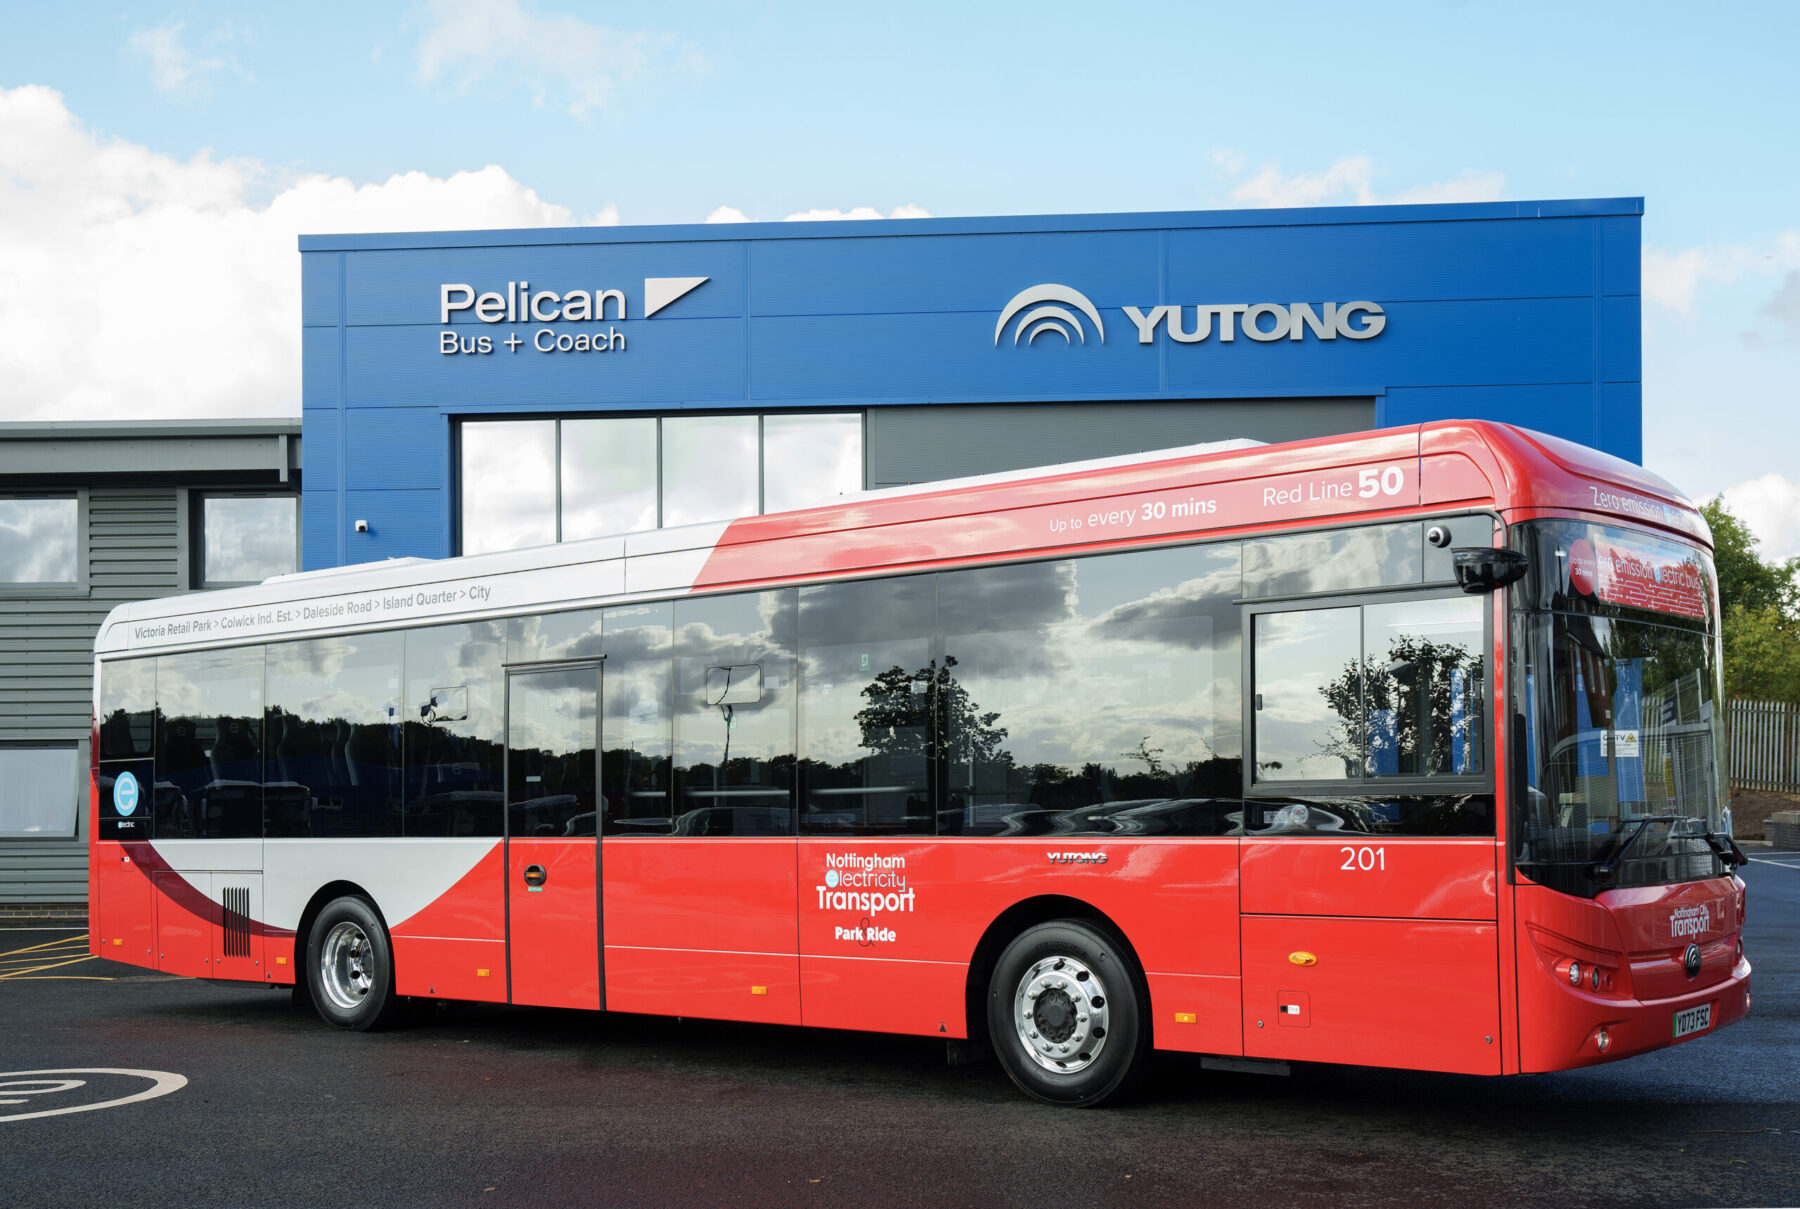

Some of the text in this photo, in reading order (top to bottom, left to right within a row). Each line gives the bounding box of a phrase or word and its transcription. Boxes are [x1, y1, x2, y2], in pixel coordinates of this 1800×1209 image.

[440, 281, 626, 323] Pelican
[1121, 301, 1386, 344] YUTONG
[440, 326, 626, 354] Bus + Coach
[1263, 466, 1404, 507] Red Line 50
[1050, 497, 1217, 533] Up to every 30 mins
[1589, 486, 1619, 509] Zero
[1621, 496, 1664, 521] emission
[1615, 559, 1653, 579] emission
[1686, 575, 1700, 590] bus
[135, 626, 165, 639] Victoria
[167, 621, 190, 636] Retail
[193, 620, 211, 633] Park
[221, 614, 255, 629] Colwick
[257, 612, 274, 625] Ind.
[277, 610, 293, 623] Est.
[303, 604, 344, 620] Daleside
[347, 600, 372, 614] Road
[383, 596, 413, 610] Island
[416, 591, 457, 606] Quarter
[469, 585, 491, 601] City
[116, 775, 136, 812] e
[825, 852, 905, 871] Nottingham
[1046, 852, 1108, 864] YUTONG
[1340, 847, 1386, 871] 201
[825, 869, 906, 892] electricity
[816, 886, 915, 917] Transport
[835, 926, 863, 941] Park
[866, 927, 896, 942] Ride
[1670, 914, 1710, 939] Transport
[1696, 1007, 1709, 1028] FSC
